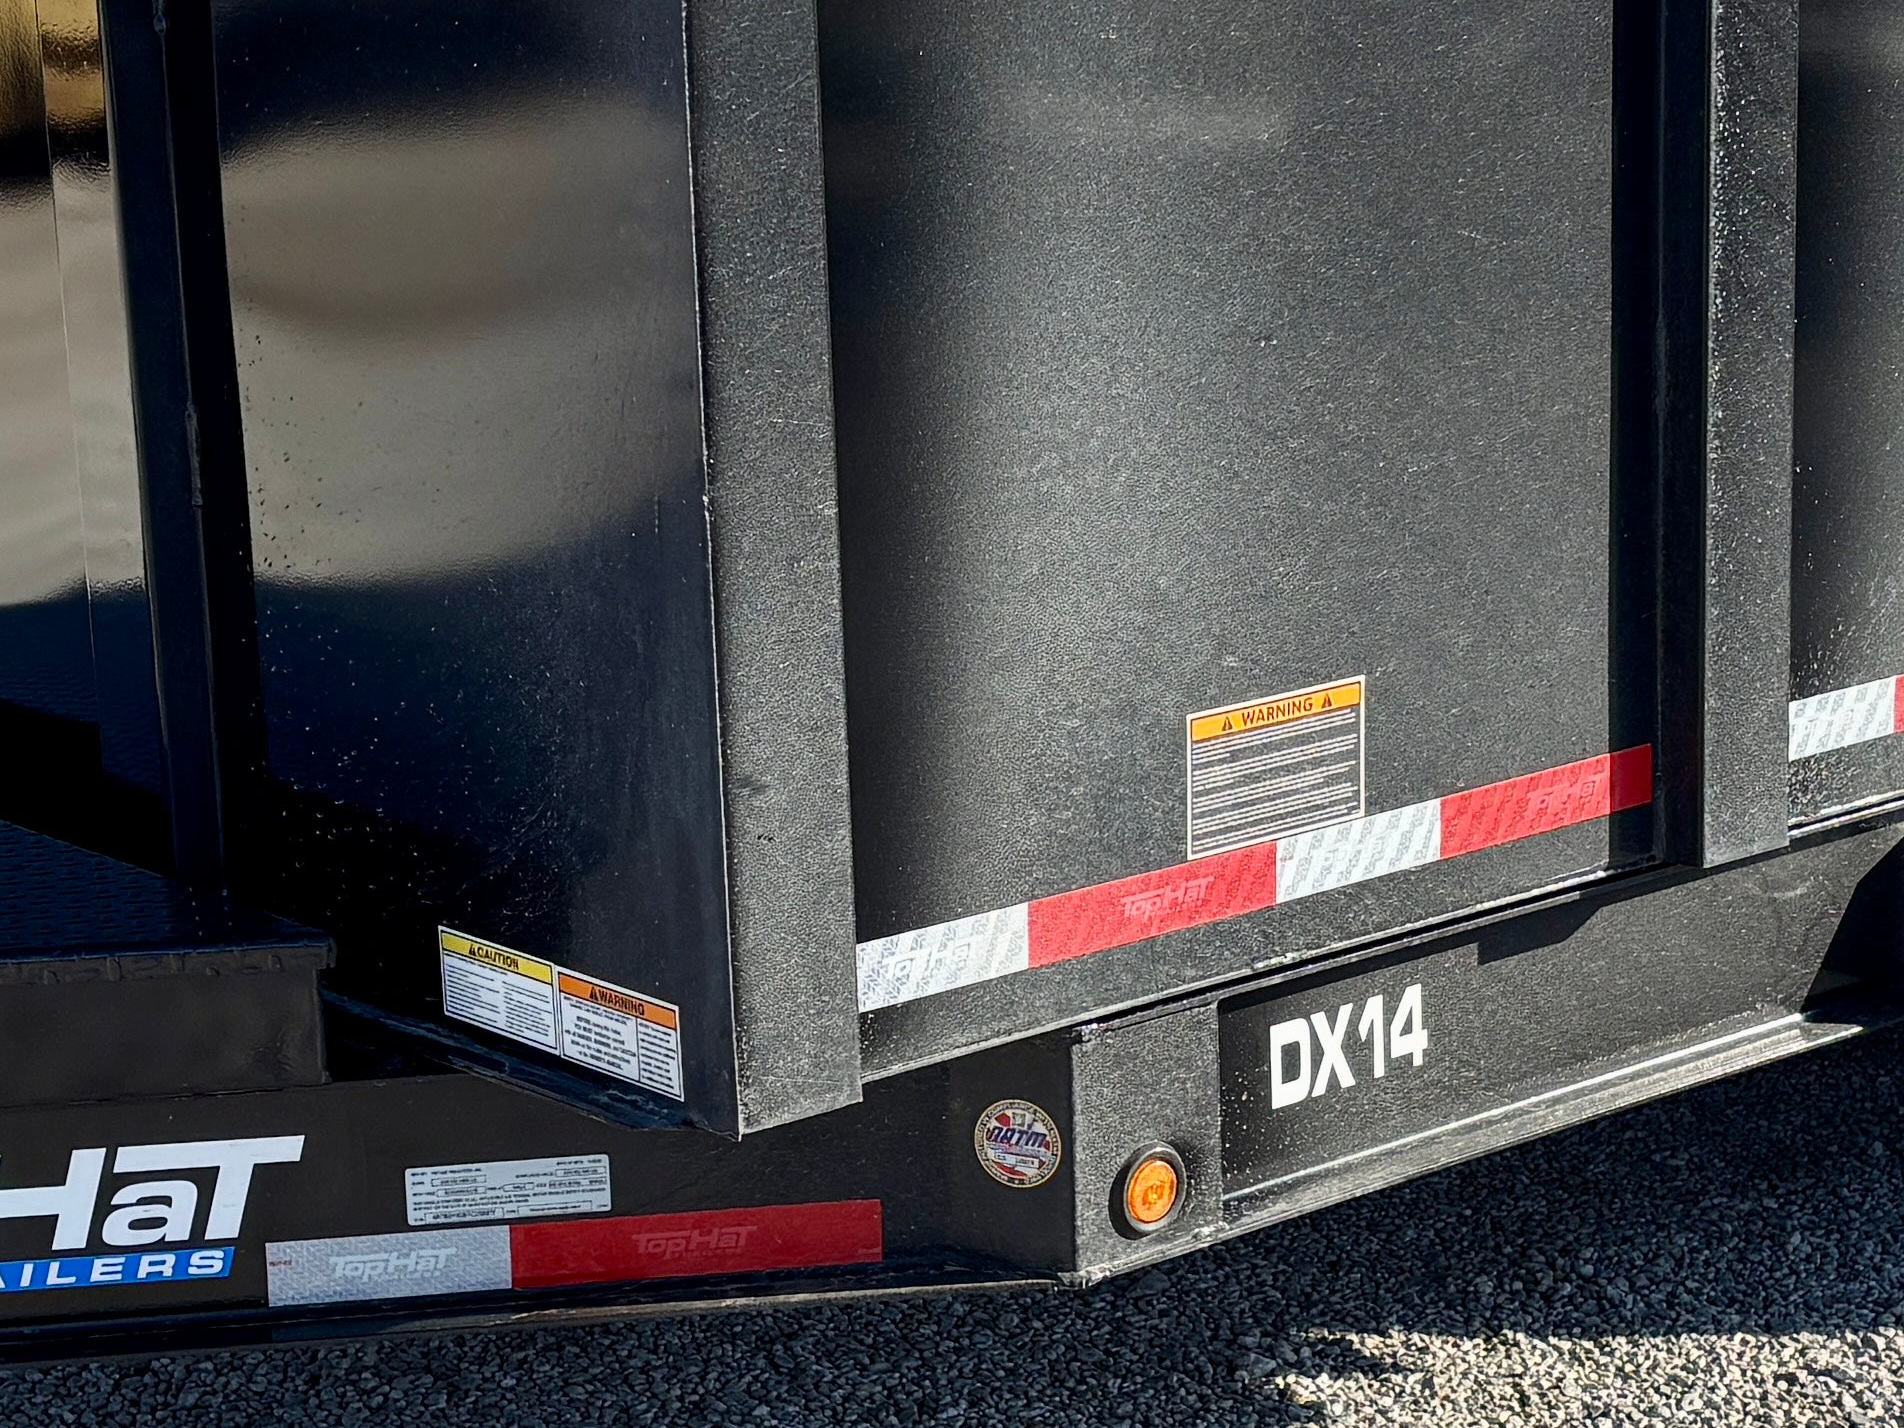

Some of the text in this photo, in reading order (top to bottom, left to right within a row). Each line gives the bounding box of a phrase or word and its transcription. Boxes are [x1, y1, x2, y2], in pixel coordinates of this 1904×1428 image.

[1241, 697, 1313, 726] WARNING
[477, 947, 520, 972] CAUTION
[598, 989, 646, 1017] WARNING
[1269, 983, 1429, 1110] DX14
